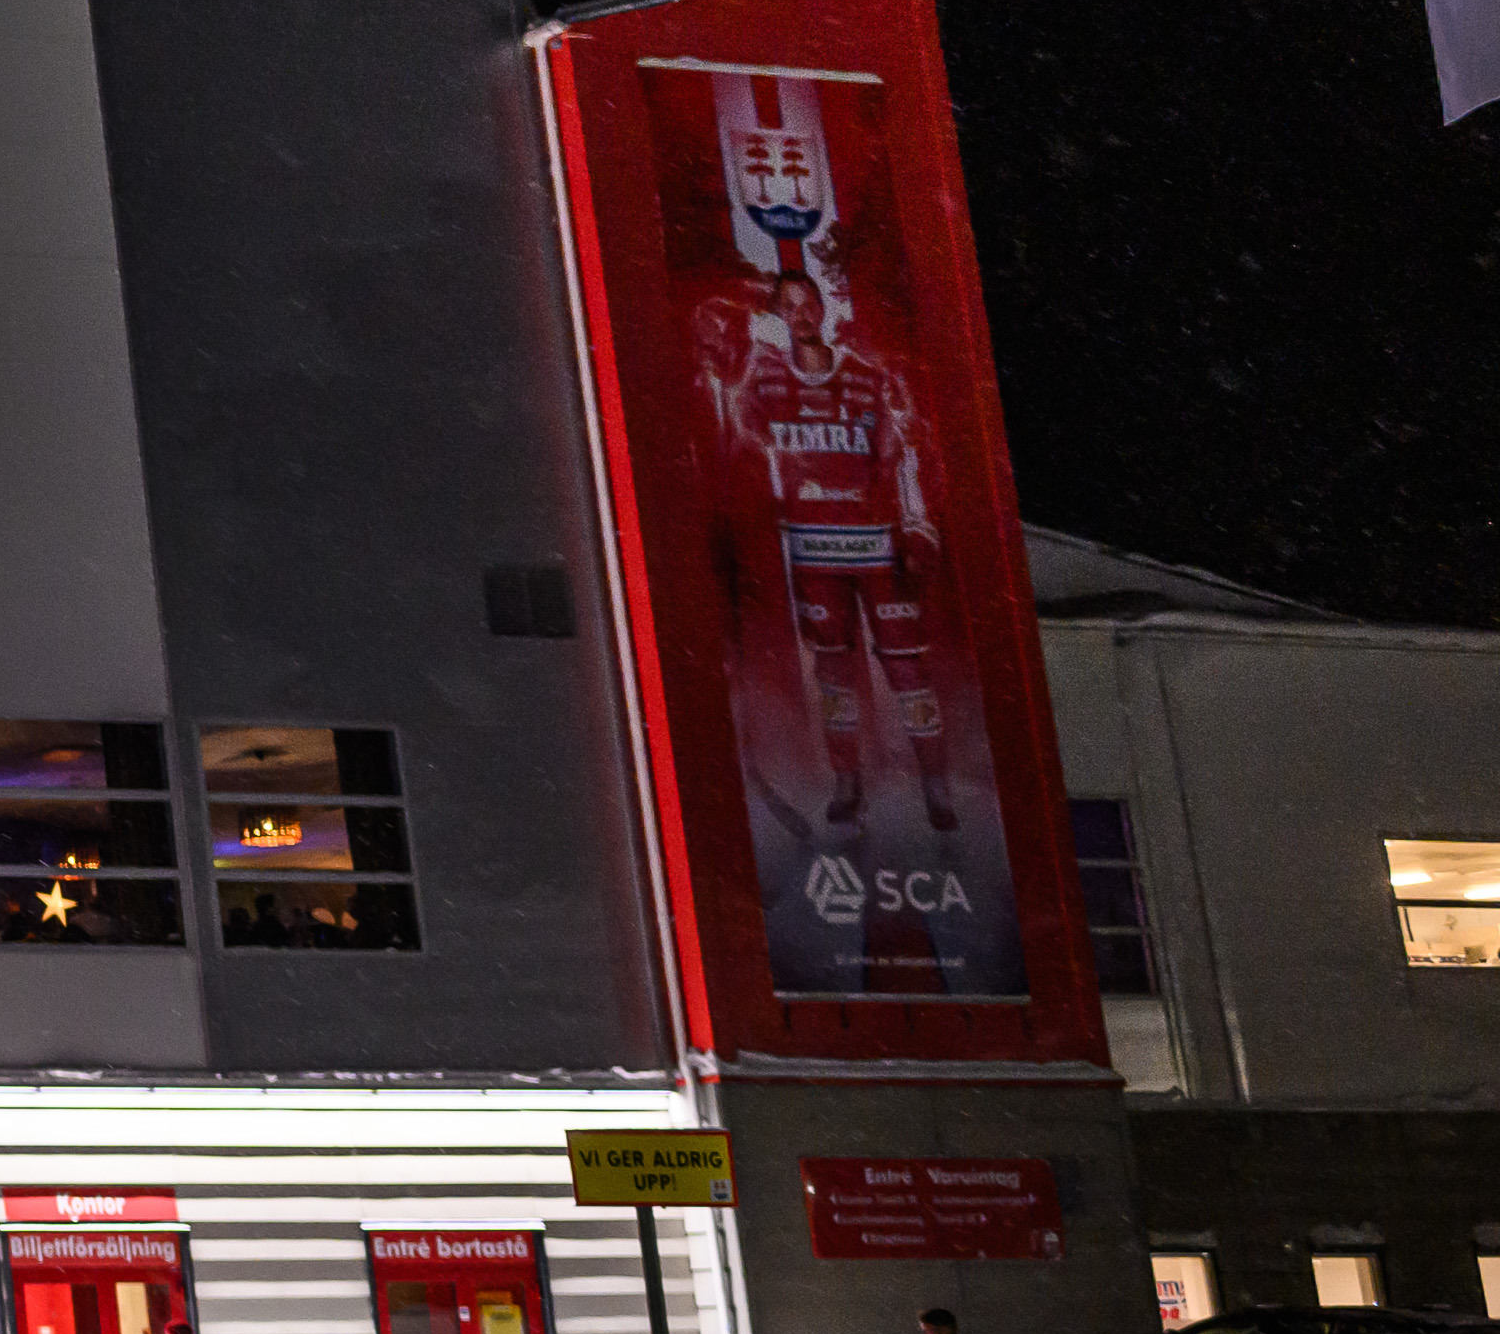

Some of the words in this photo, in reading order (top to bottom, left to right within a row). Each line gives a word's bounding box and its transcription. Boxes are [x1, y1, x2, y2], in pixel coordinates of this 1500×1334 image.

[875, 870, 973, 913] SCA
[579, 1150, 600, 1167] VI
[607, 1150, 645, 1168] GER
[654, 1150, 723, 1169] ALDRIG
[633, 1174, 677, 1191] UPP!
[56, 1194, 126, 1217] Kontor
[10, 1234, 176, 1263] Biljettförsäljning
[373, 1236, 431, 1258] Entré
[436, 1234, 528, 1258] bortastå
